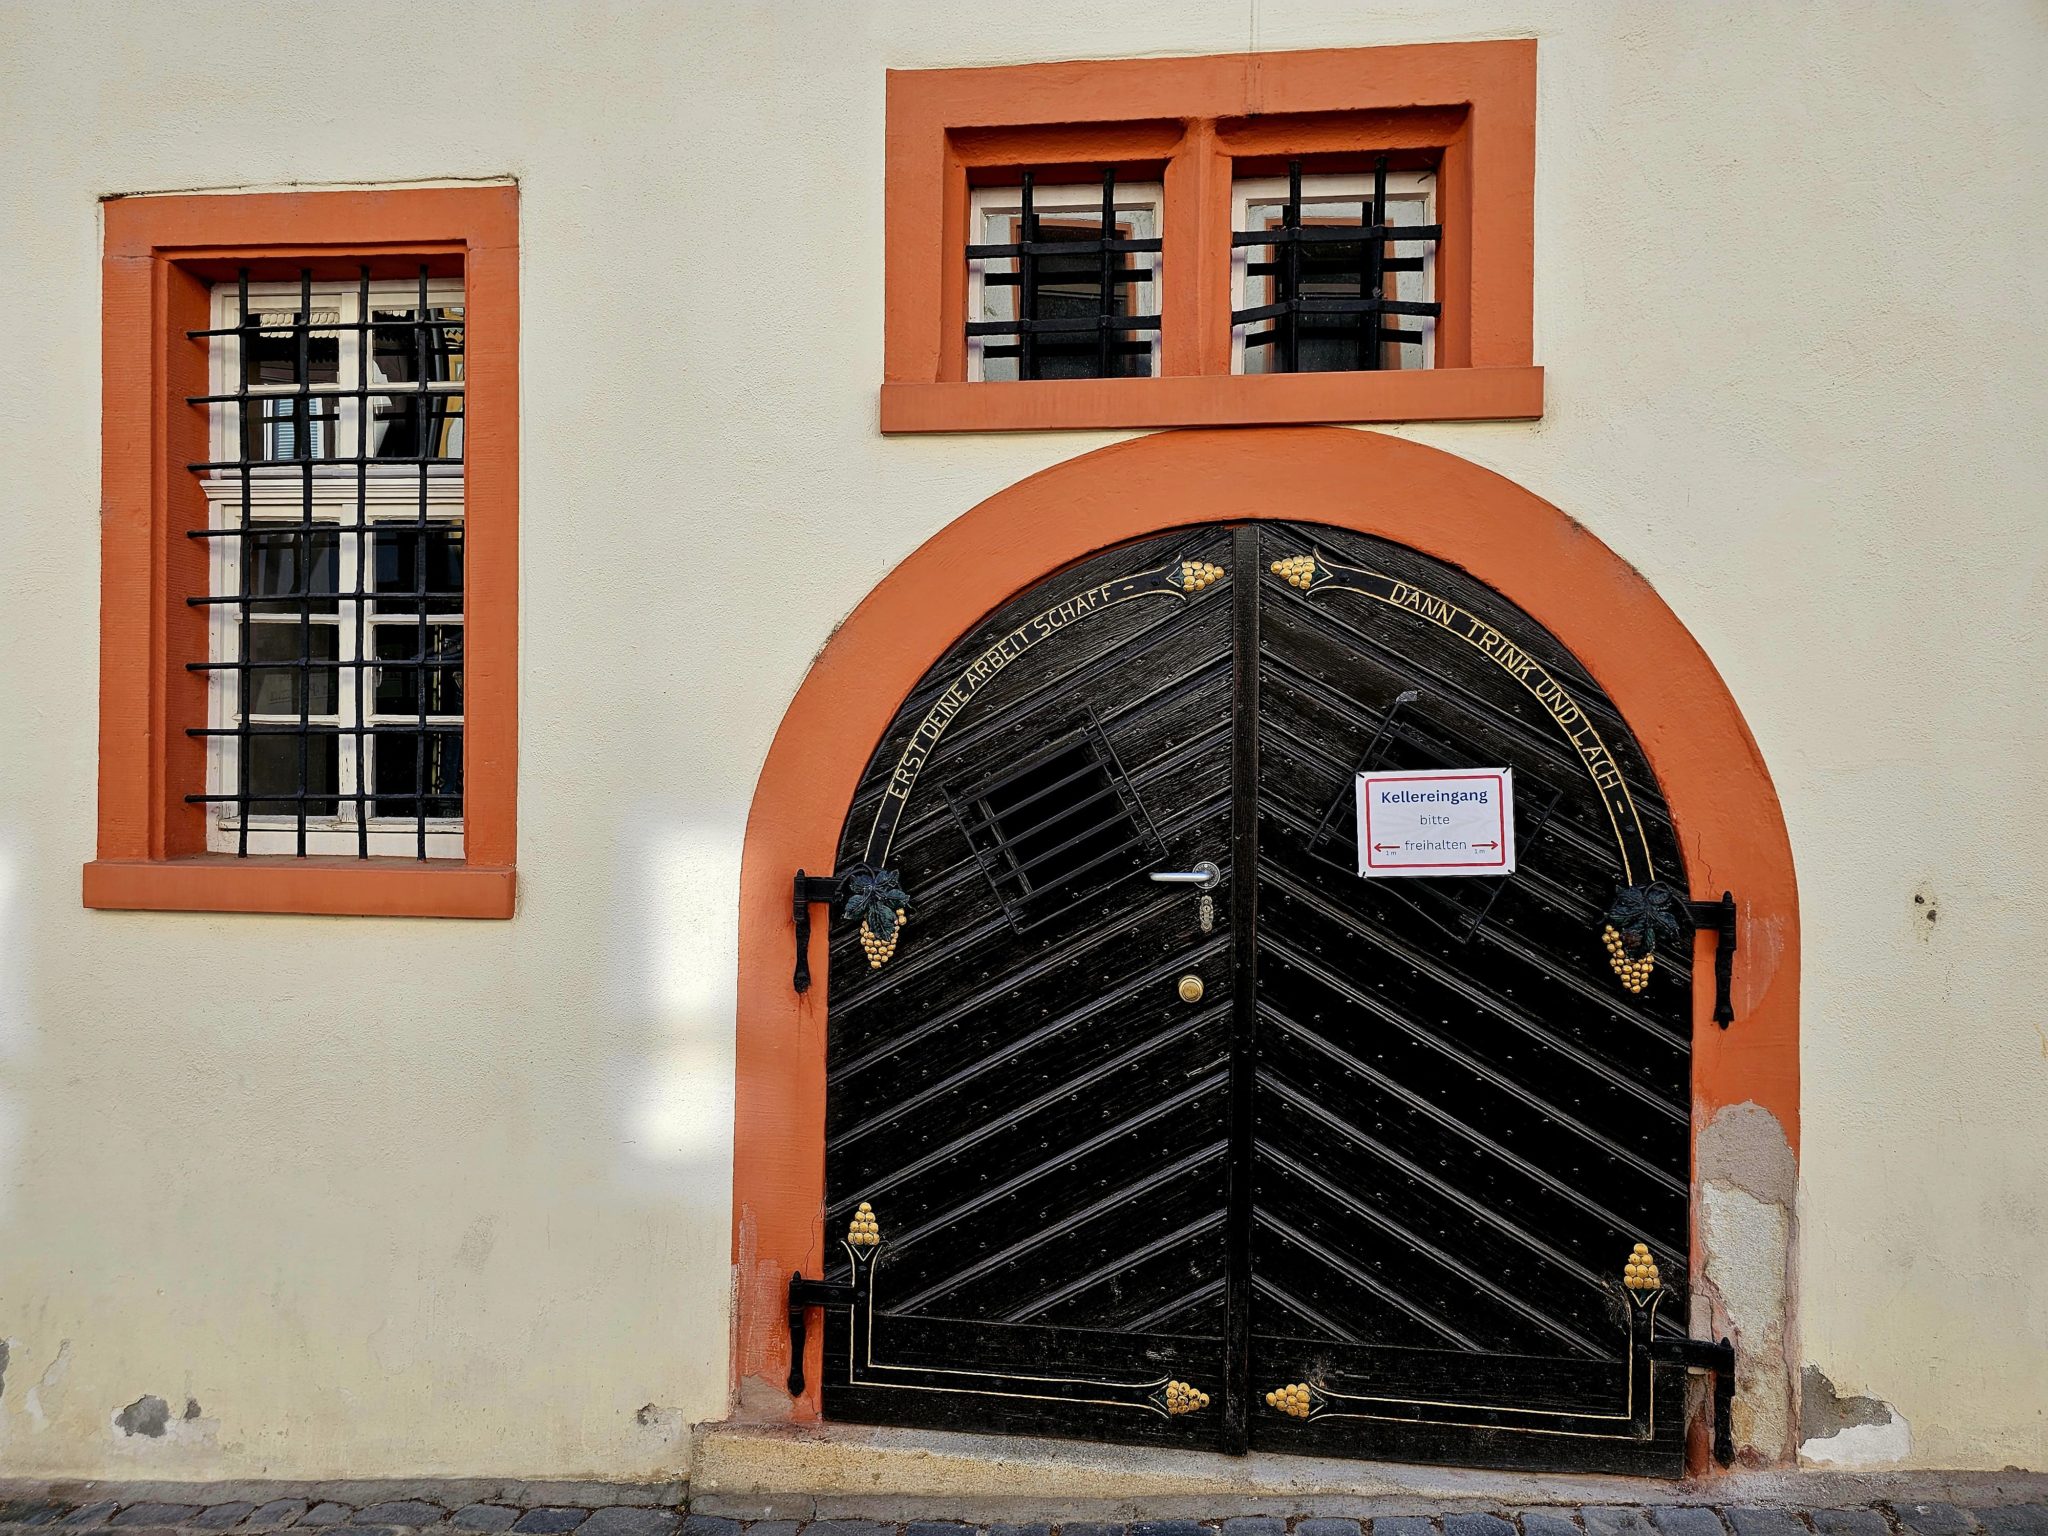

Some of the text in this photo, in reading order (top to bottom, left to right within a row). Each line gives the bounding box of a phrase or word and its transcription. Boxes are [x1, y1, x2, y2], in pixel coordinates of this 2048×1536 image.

[889, 740, 925, 800] ERST
[921, 682, 969, 741] DEINE
[966, 627, 1029, 689] ARBEIT
[1033, 584, 1111, 637] SCHAFF
[1390, 583, 1457, 625] DANN
[1468, 619, 1537, 680] TRINK
[1535, 678, 1579, 724] UND
[1572, 727, 1621, 790] LACH
[1381, 789, 1488, 805] Kellereingang
[1420, 814, 1450, 825] bitte
[1405, 840, 1467, 851] freihalten
